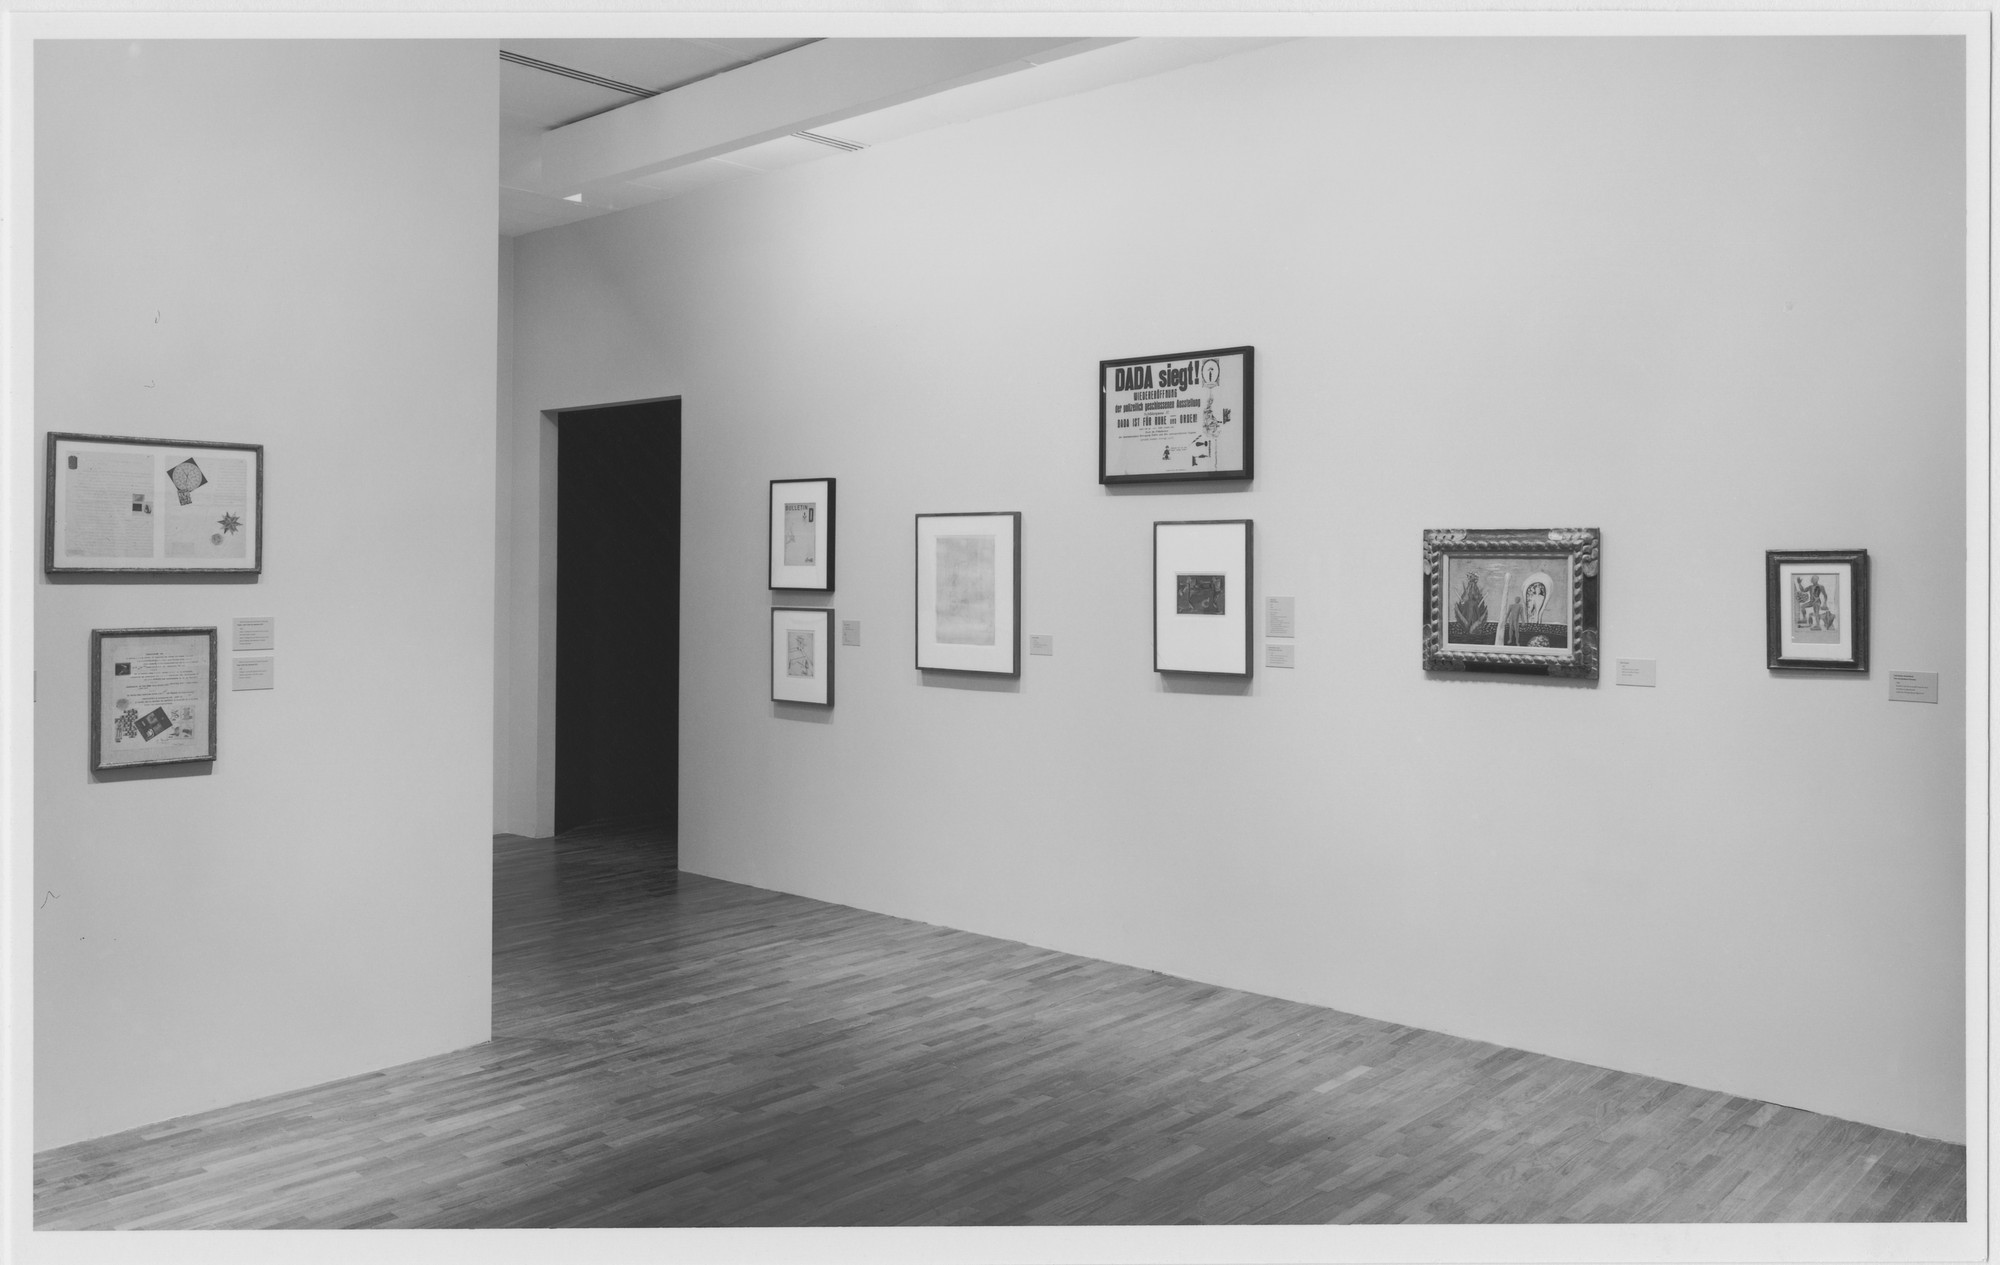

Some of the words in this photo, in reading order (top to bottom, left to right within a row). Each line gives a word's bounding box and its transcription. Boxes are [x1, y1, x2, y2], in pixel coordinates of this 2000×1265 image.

[1115, 365, 1153, 392] DADA
[1159, 360, 1200, 392] siegt!
[1132, 417, 1140, 427] IST
